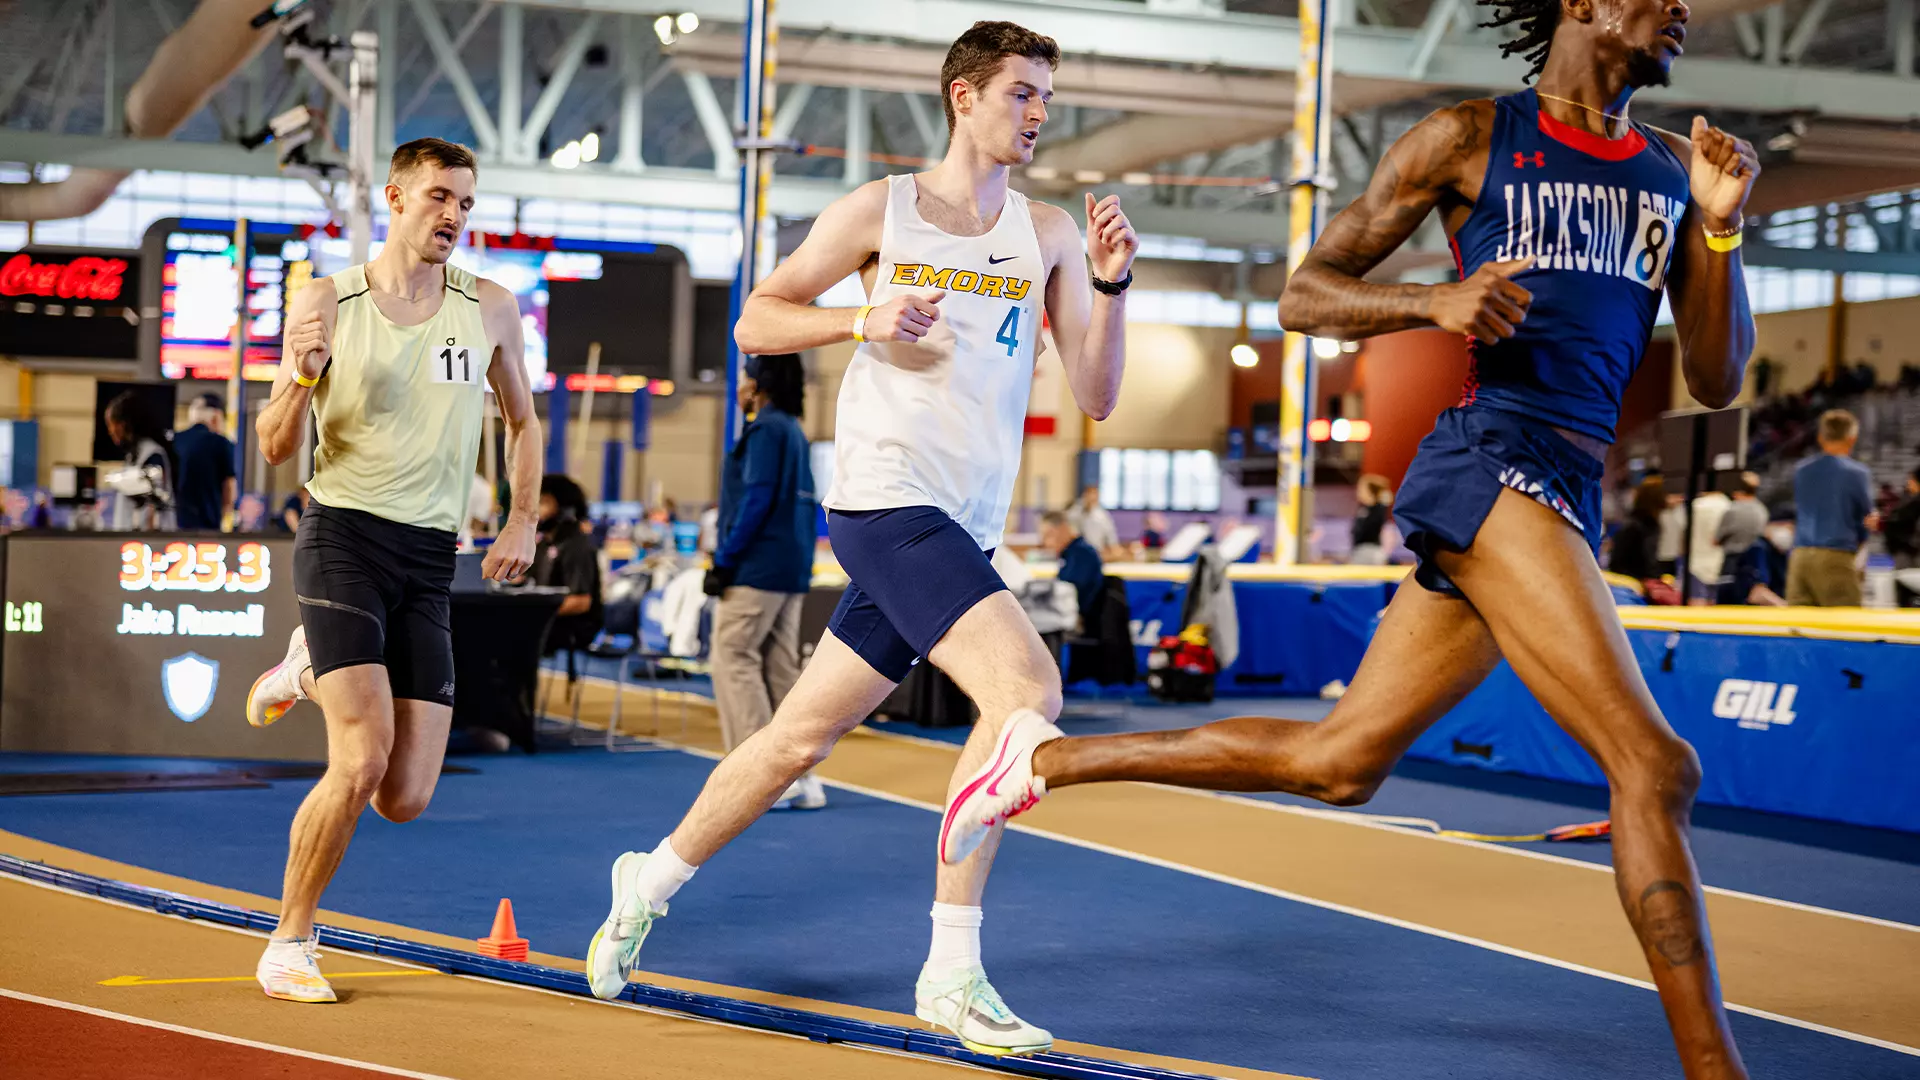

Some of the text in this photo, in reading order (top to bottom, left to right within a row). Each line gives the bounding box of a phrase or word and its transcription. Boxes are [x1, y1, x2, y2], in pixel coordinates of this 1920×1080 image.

[1497, 182, 1628, 277] JACKSON
[1635, 219, 1668, 281] 8
[890, 263, 1032, 301] EMORY
[996, 306, 1020, 357] 4
[440, 348, 469, 381] 11
[118, 541, 271, 592] 3:25.3
[1712, 678, 1798, 725] GILL
